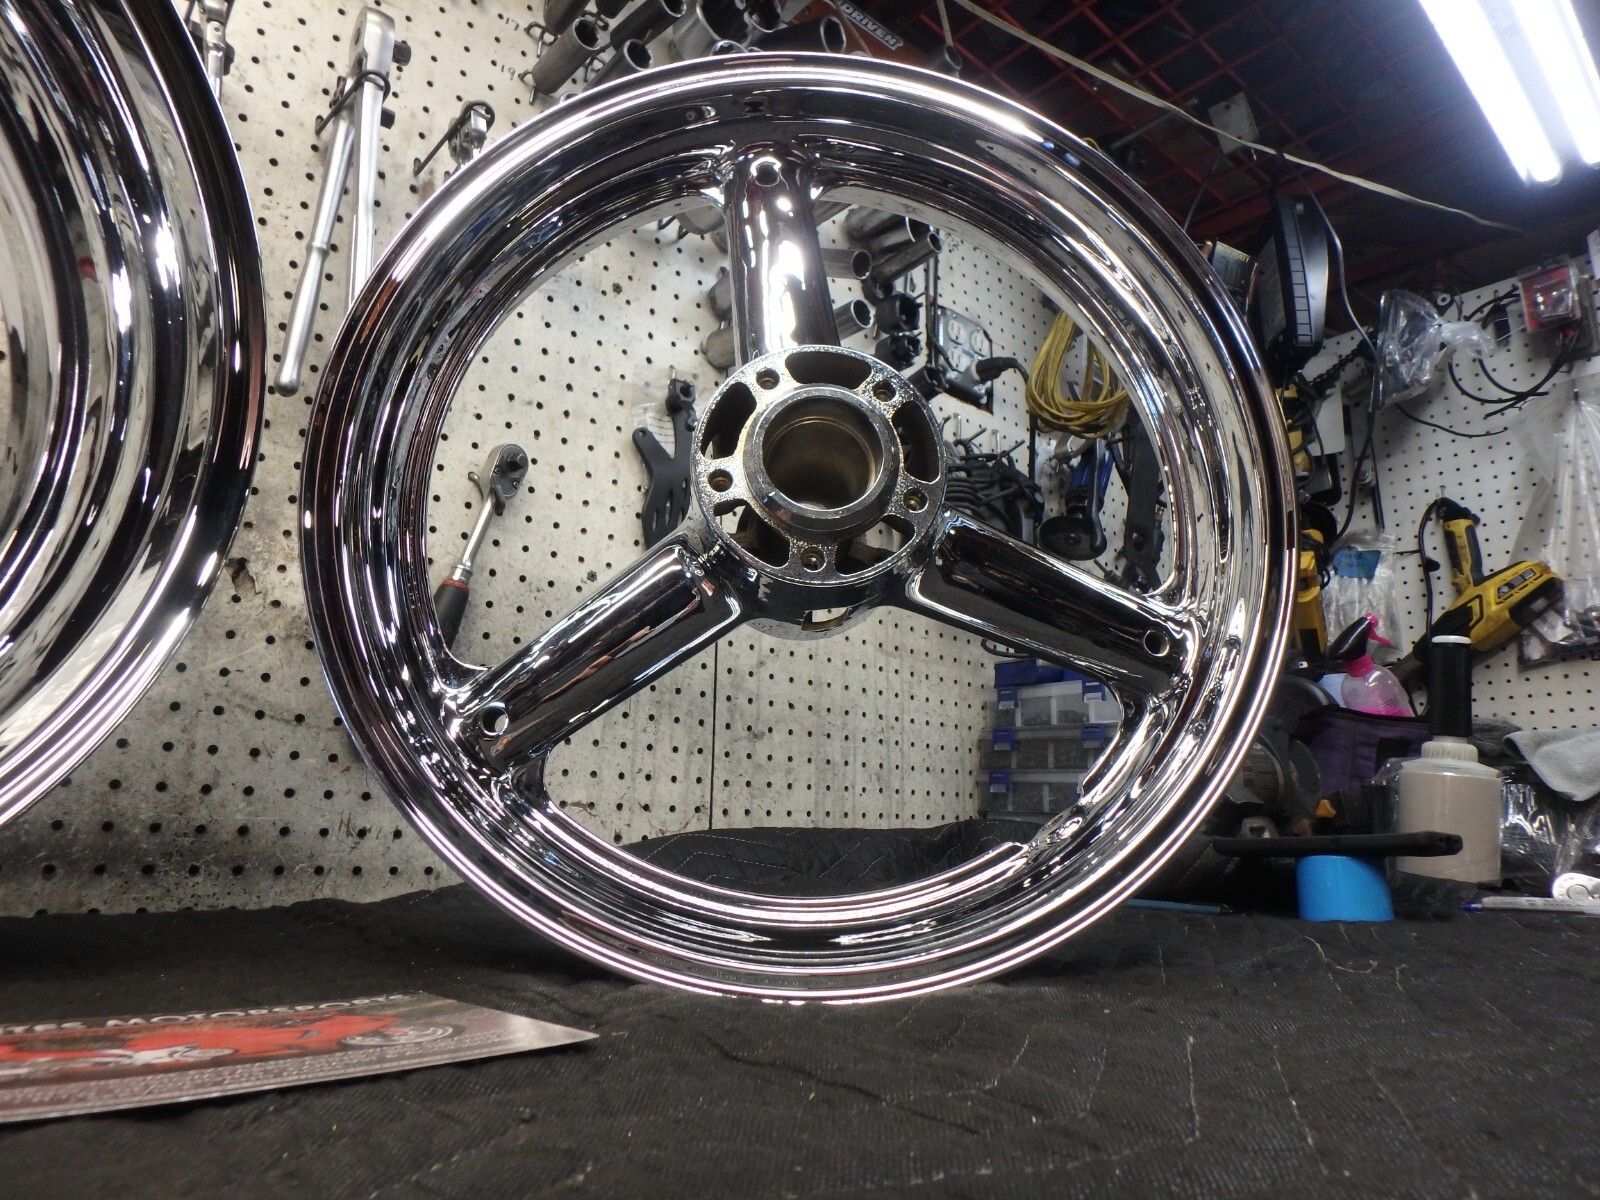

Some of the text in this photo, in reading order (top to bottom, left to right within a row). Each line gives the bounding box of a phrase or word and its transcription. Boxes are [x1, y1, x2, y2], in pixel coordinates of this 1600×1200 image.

[505, 17, 520, 32] 17
[841, 2, 898, 46] DRIVEN
[501, 64, 516, 81] 19
